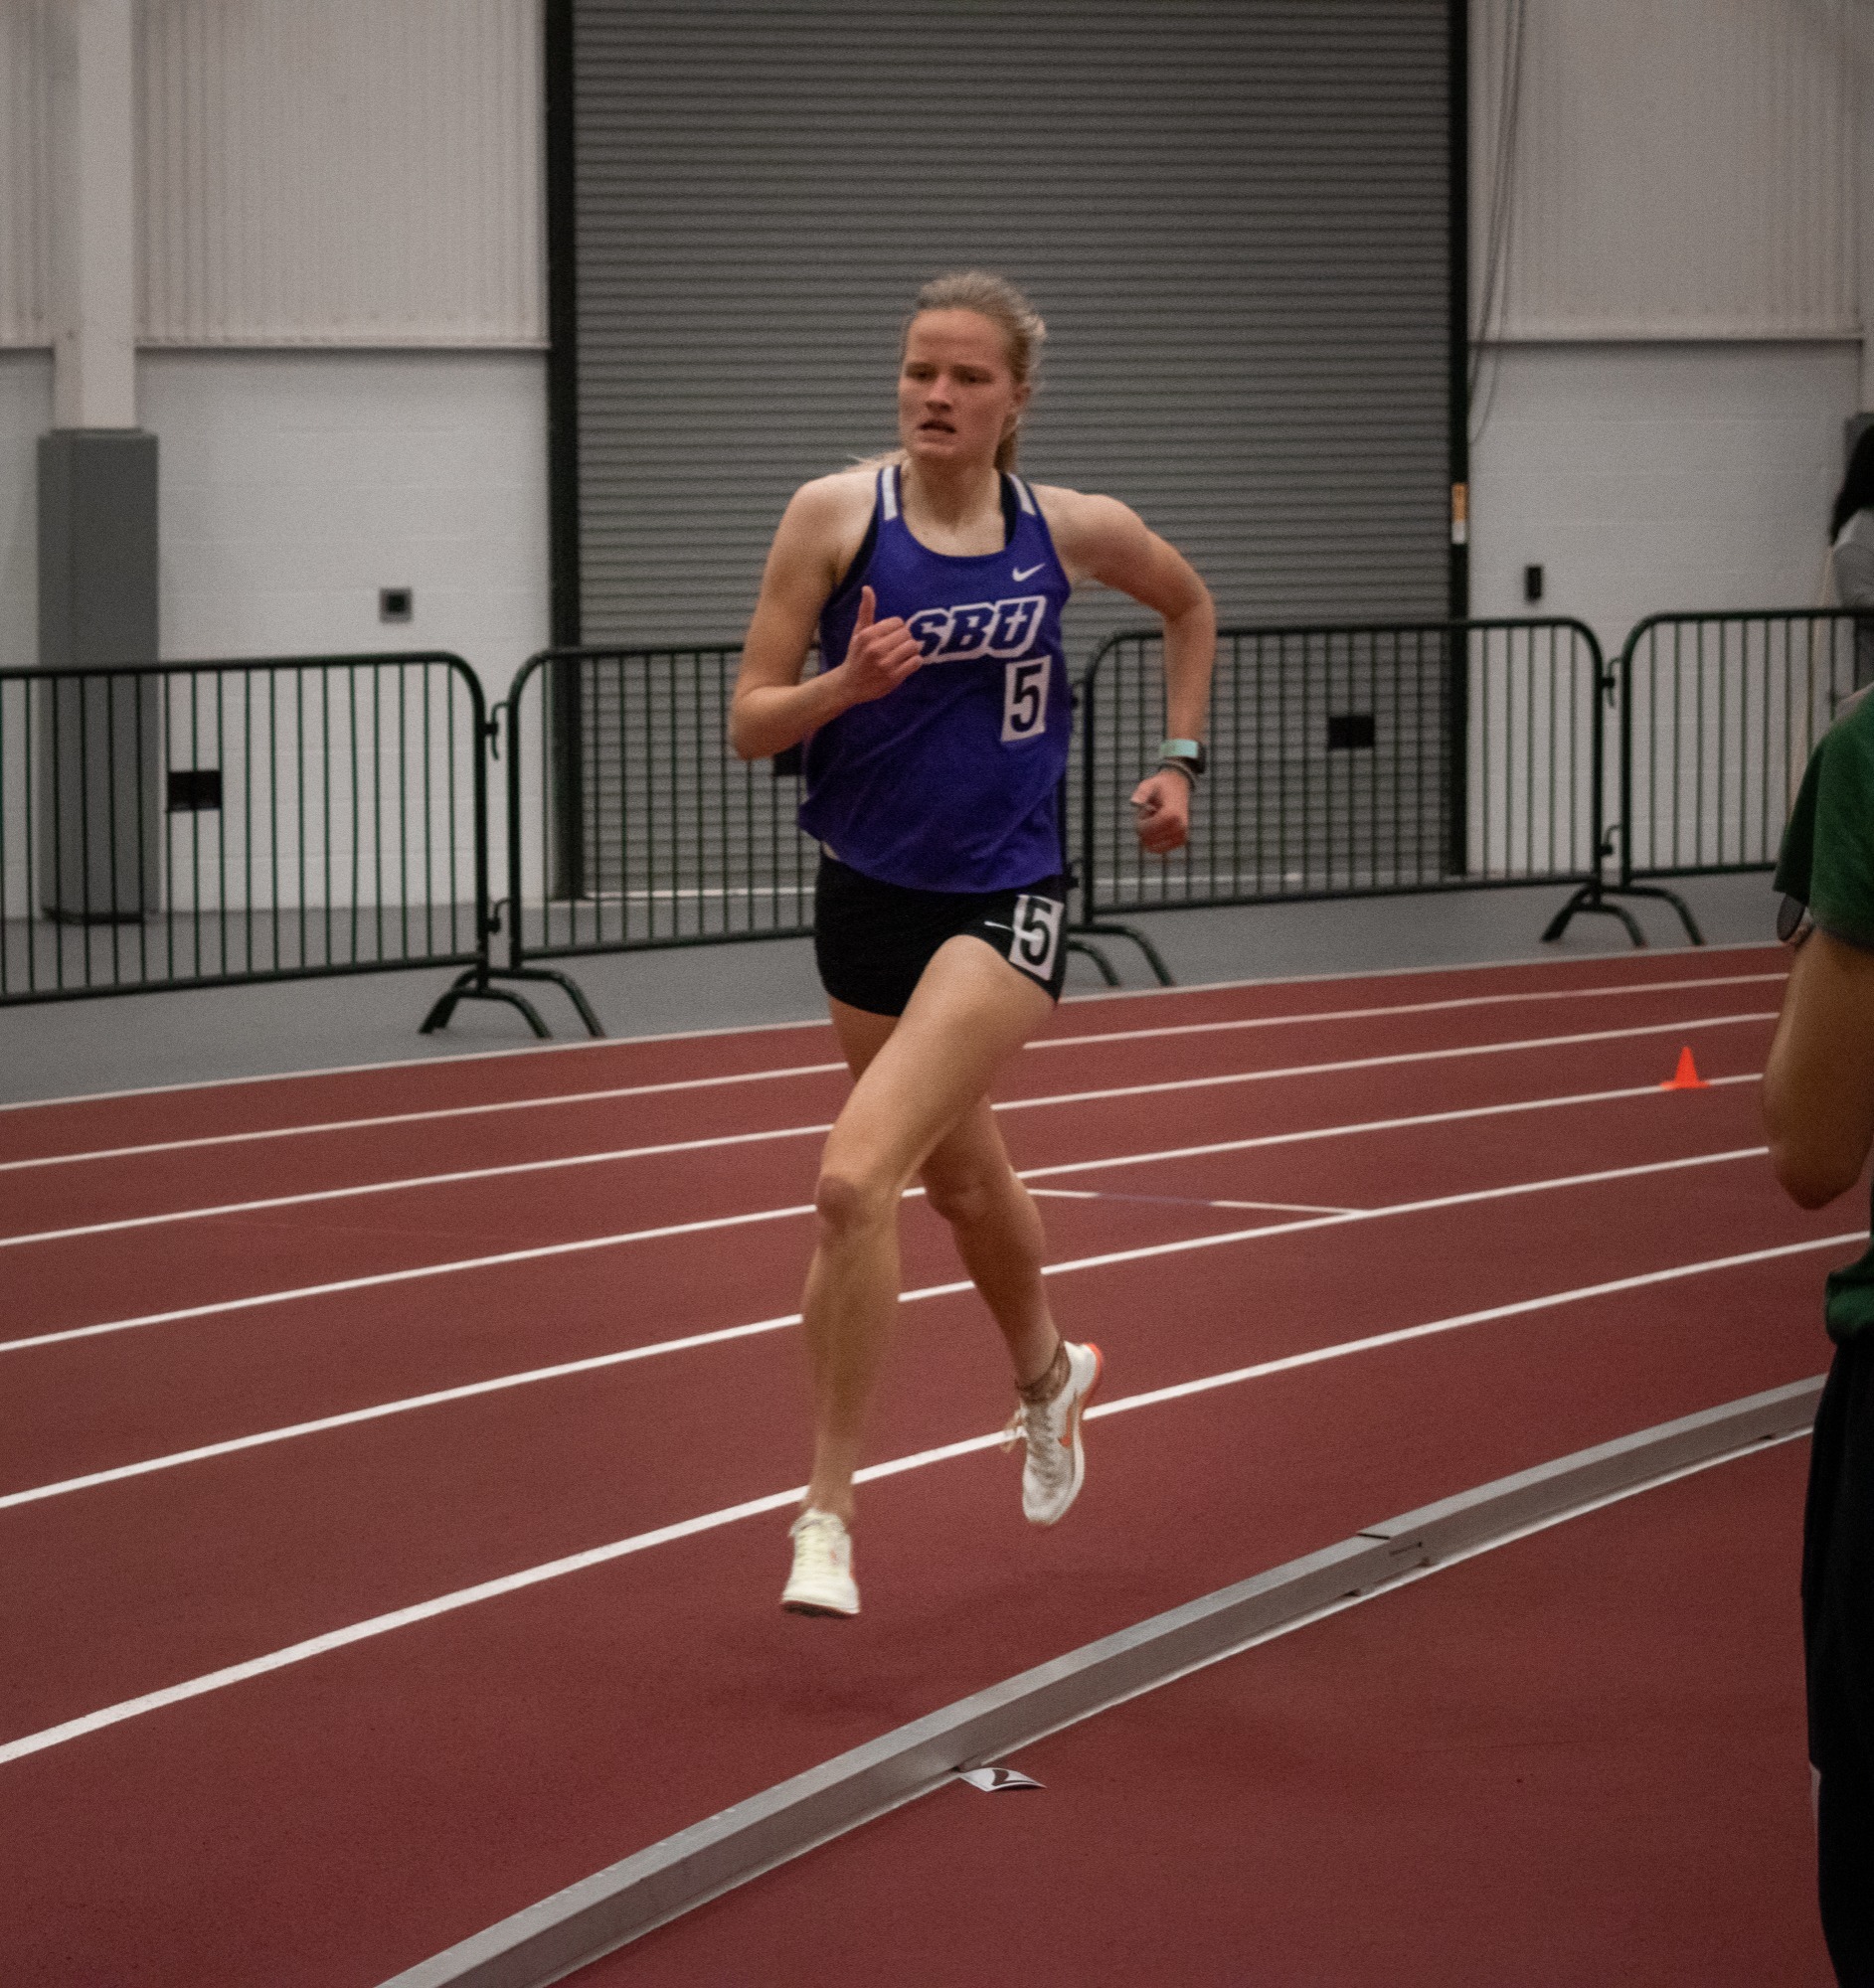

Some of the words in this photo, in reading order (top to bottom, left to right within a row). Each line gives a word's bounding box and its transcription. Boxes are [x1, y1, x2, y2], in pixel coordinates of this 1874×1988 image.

[907, 596, 1046, 663] SBU
[1010, 663, 1042, 733] 5
[1020, 897, 1052, 966] 5
